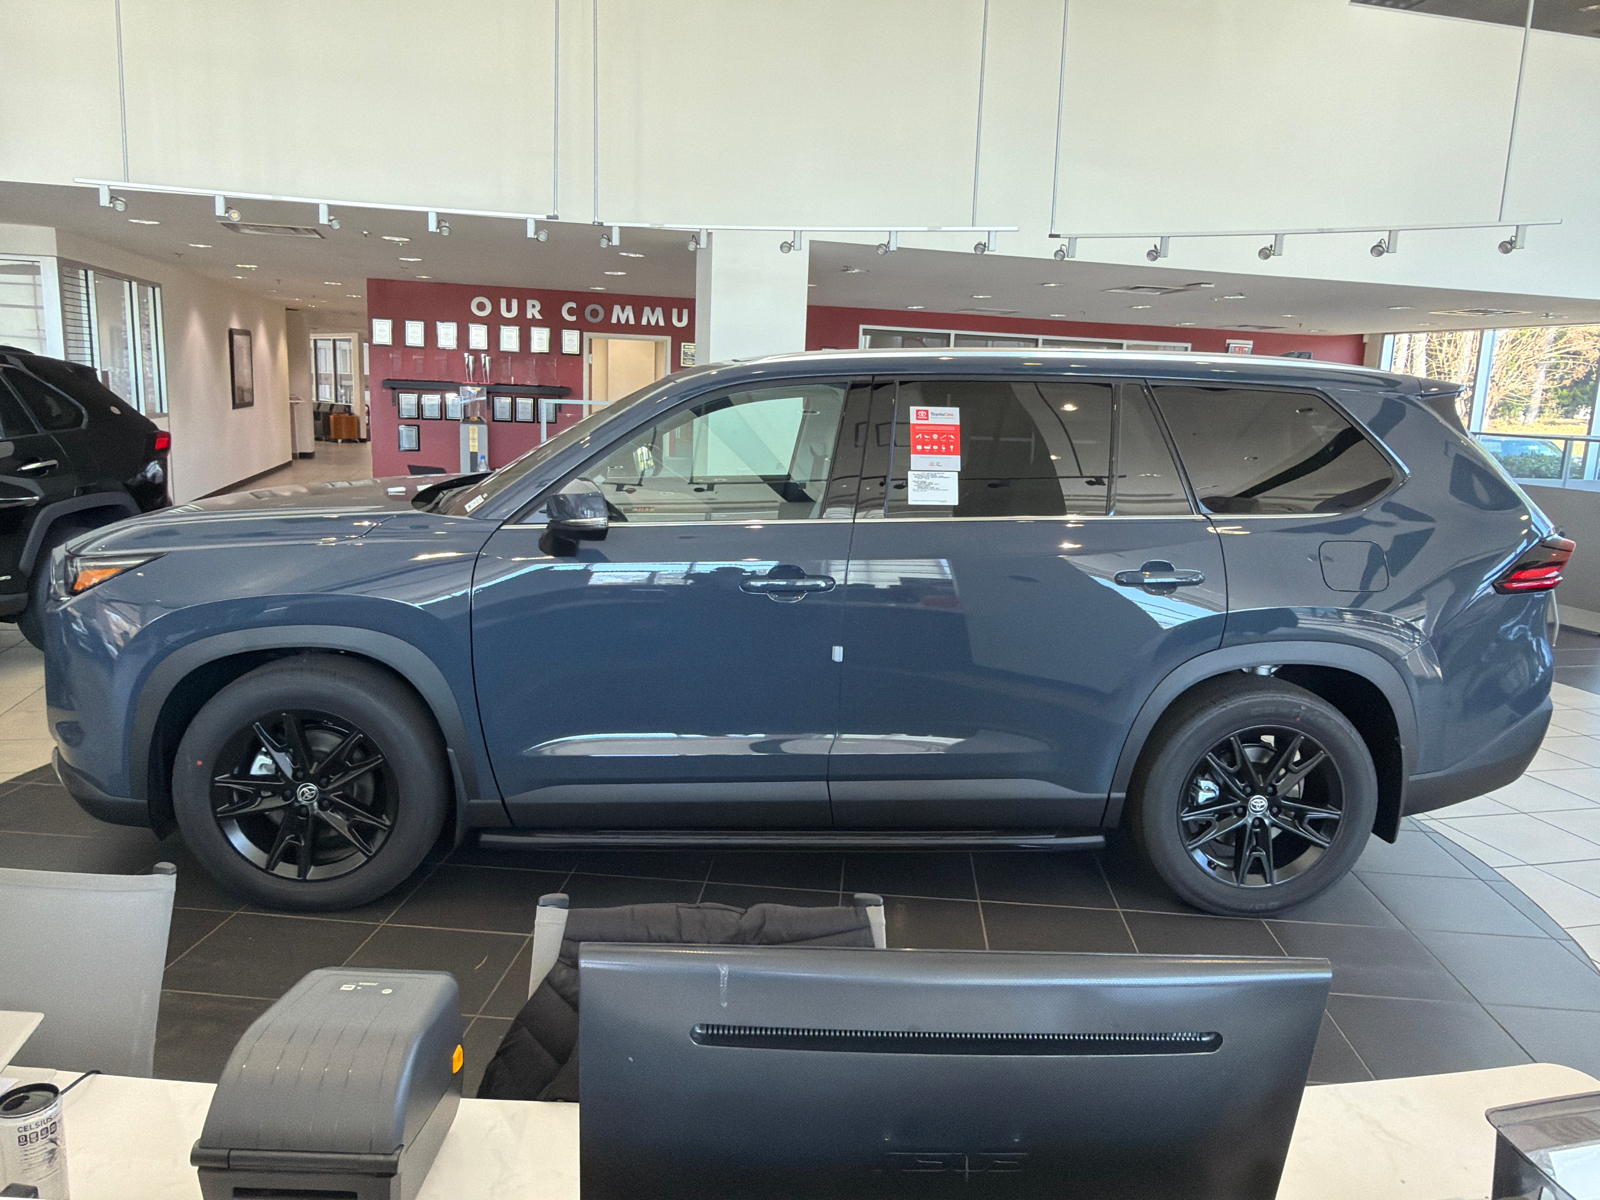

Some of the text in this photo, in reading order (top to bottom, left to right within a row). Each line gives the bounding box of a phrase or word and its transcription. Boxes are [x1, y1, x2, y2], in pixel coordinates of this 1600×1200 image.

[470, 296, 689, 328] OUR COMMU
[17, 1117, 53, 1133] CELSIUS
